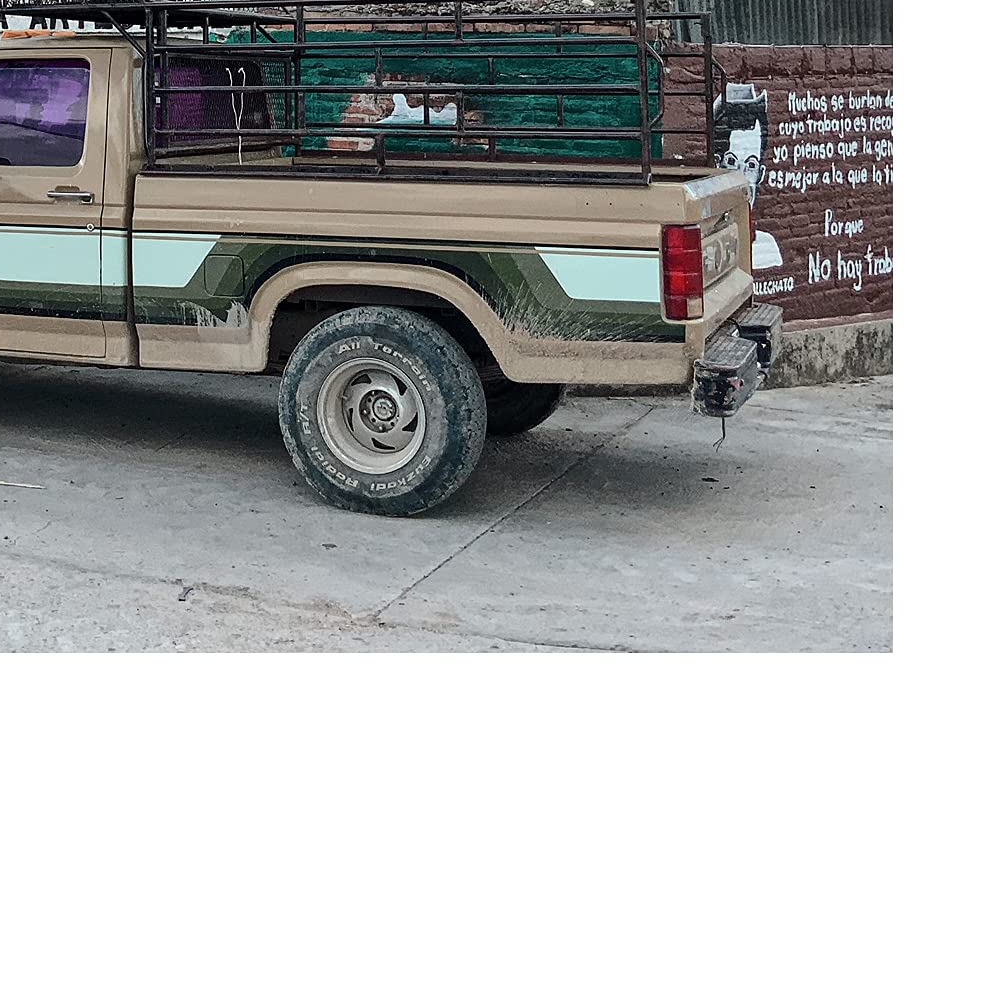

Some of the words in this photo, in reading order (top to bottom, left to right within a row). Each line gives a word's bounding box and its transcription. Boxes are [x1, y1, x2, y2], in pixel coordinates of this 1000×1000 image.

[788, 90, 828, 115] Muchos
[831, 94, 845, 112] se
[848, 89, 883, 110] burlan
[805, 113, 852, 139] trabajo
[853, 116, 867, 132] es
[772, 144, 788, 164] yo
[793, 140, 834, 166] pienso
[837, 140, 858, 161] que
[863, 135, 873, 154] la
[784, 166, 820, 194] mejor
[822, 171, 830, 184] a
[831, 162, 843, 184] la
[847, 168, 868, 189] que
[872, 164, 883, 186] la
[808, 250, 831, 284] No
[837, 249, 863, 291] hay
[338, 342, 361, 355] All
[373, 343, 432, 392] Terrain
[310, 446, 359, 488] Radial
